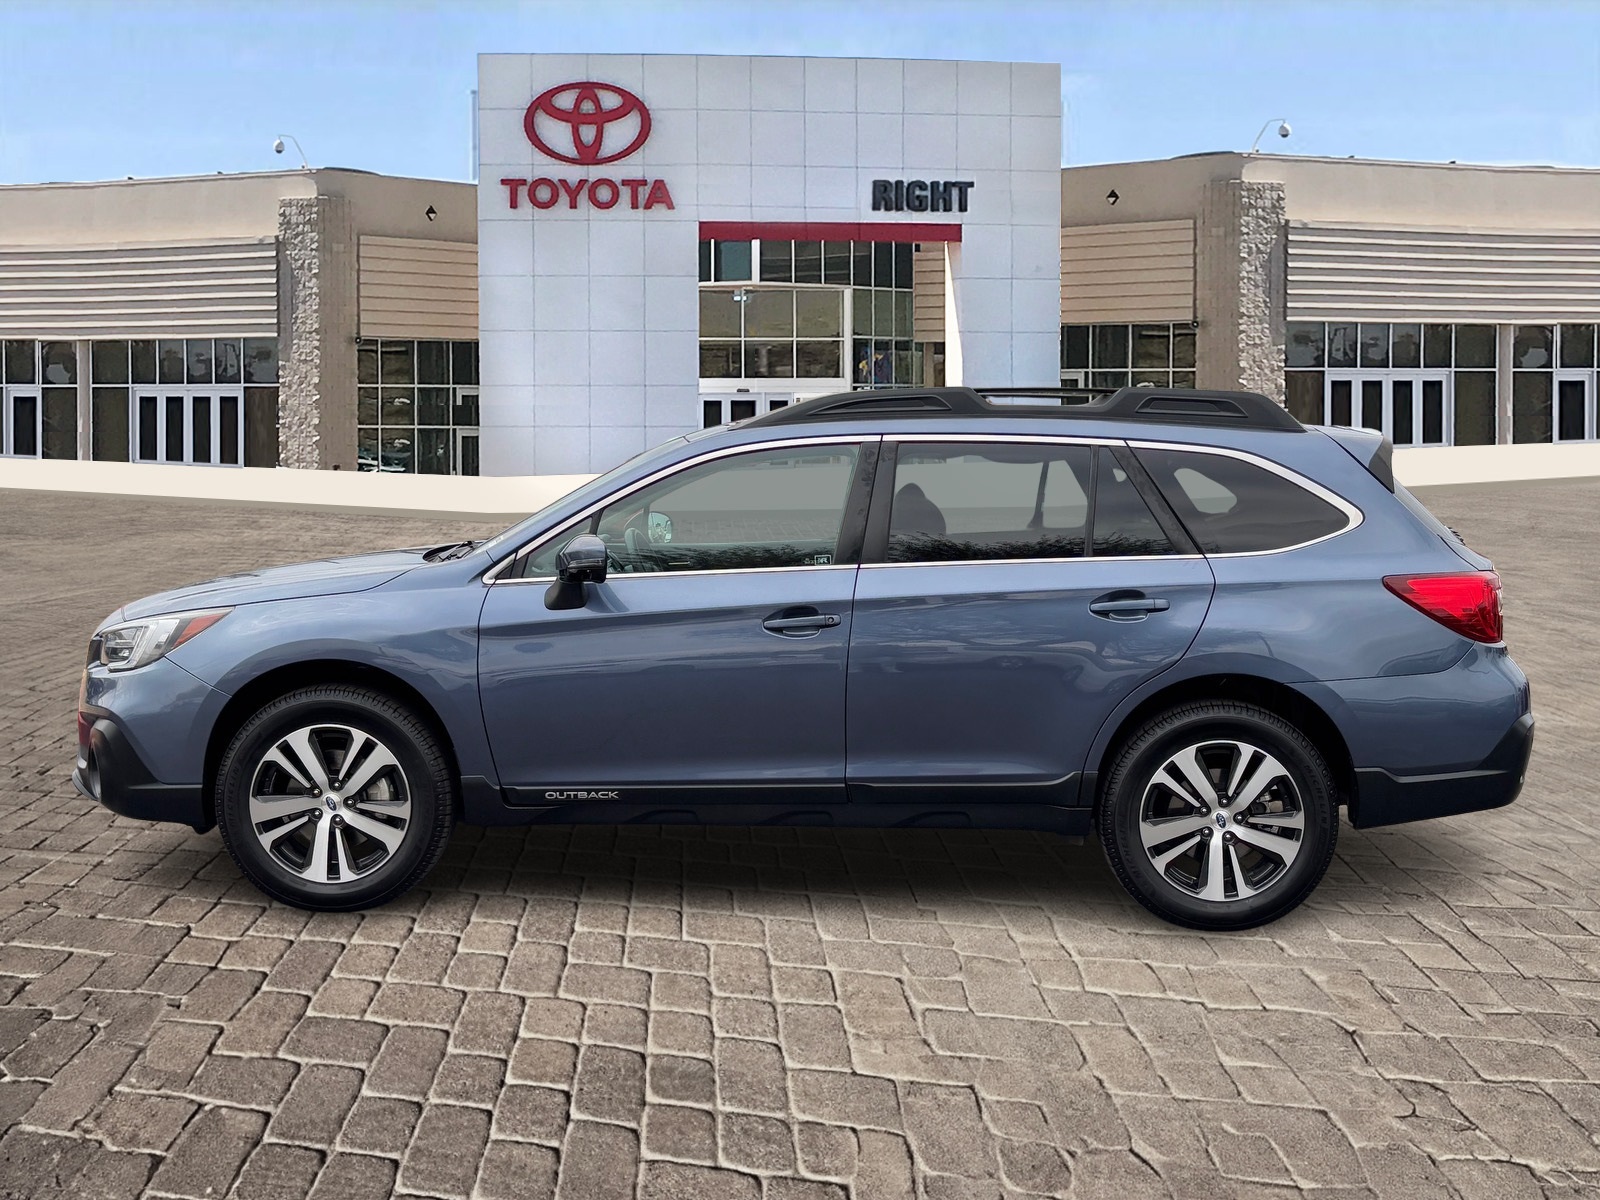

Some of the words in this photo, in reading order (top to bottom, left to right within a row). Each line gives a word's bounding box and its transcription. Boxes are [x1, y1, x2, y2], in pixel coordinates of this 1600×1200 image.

[500, 177, 675, 210] TOYOTA
[872, 179, 975, 213] RIGHT
[544, 791, 619, 799] OUTBACK
